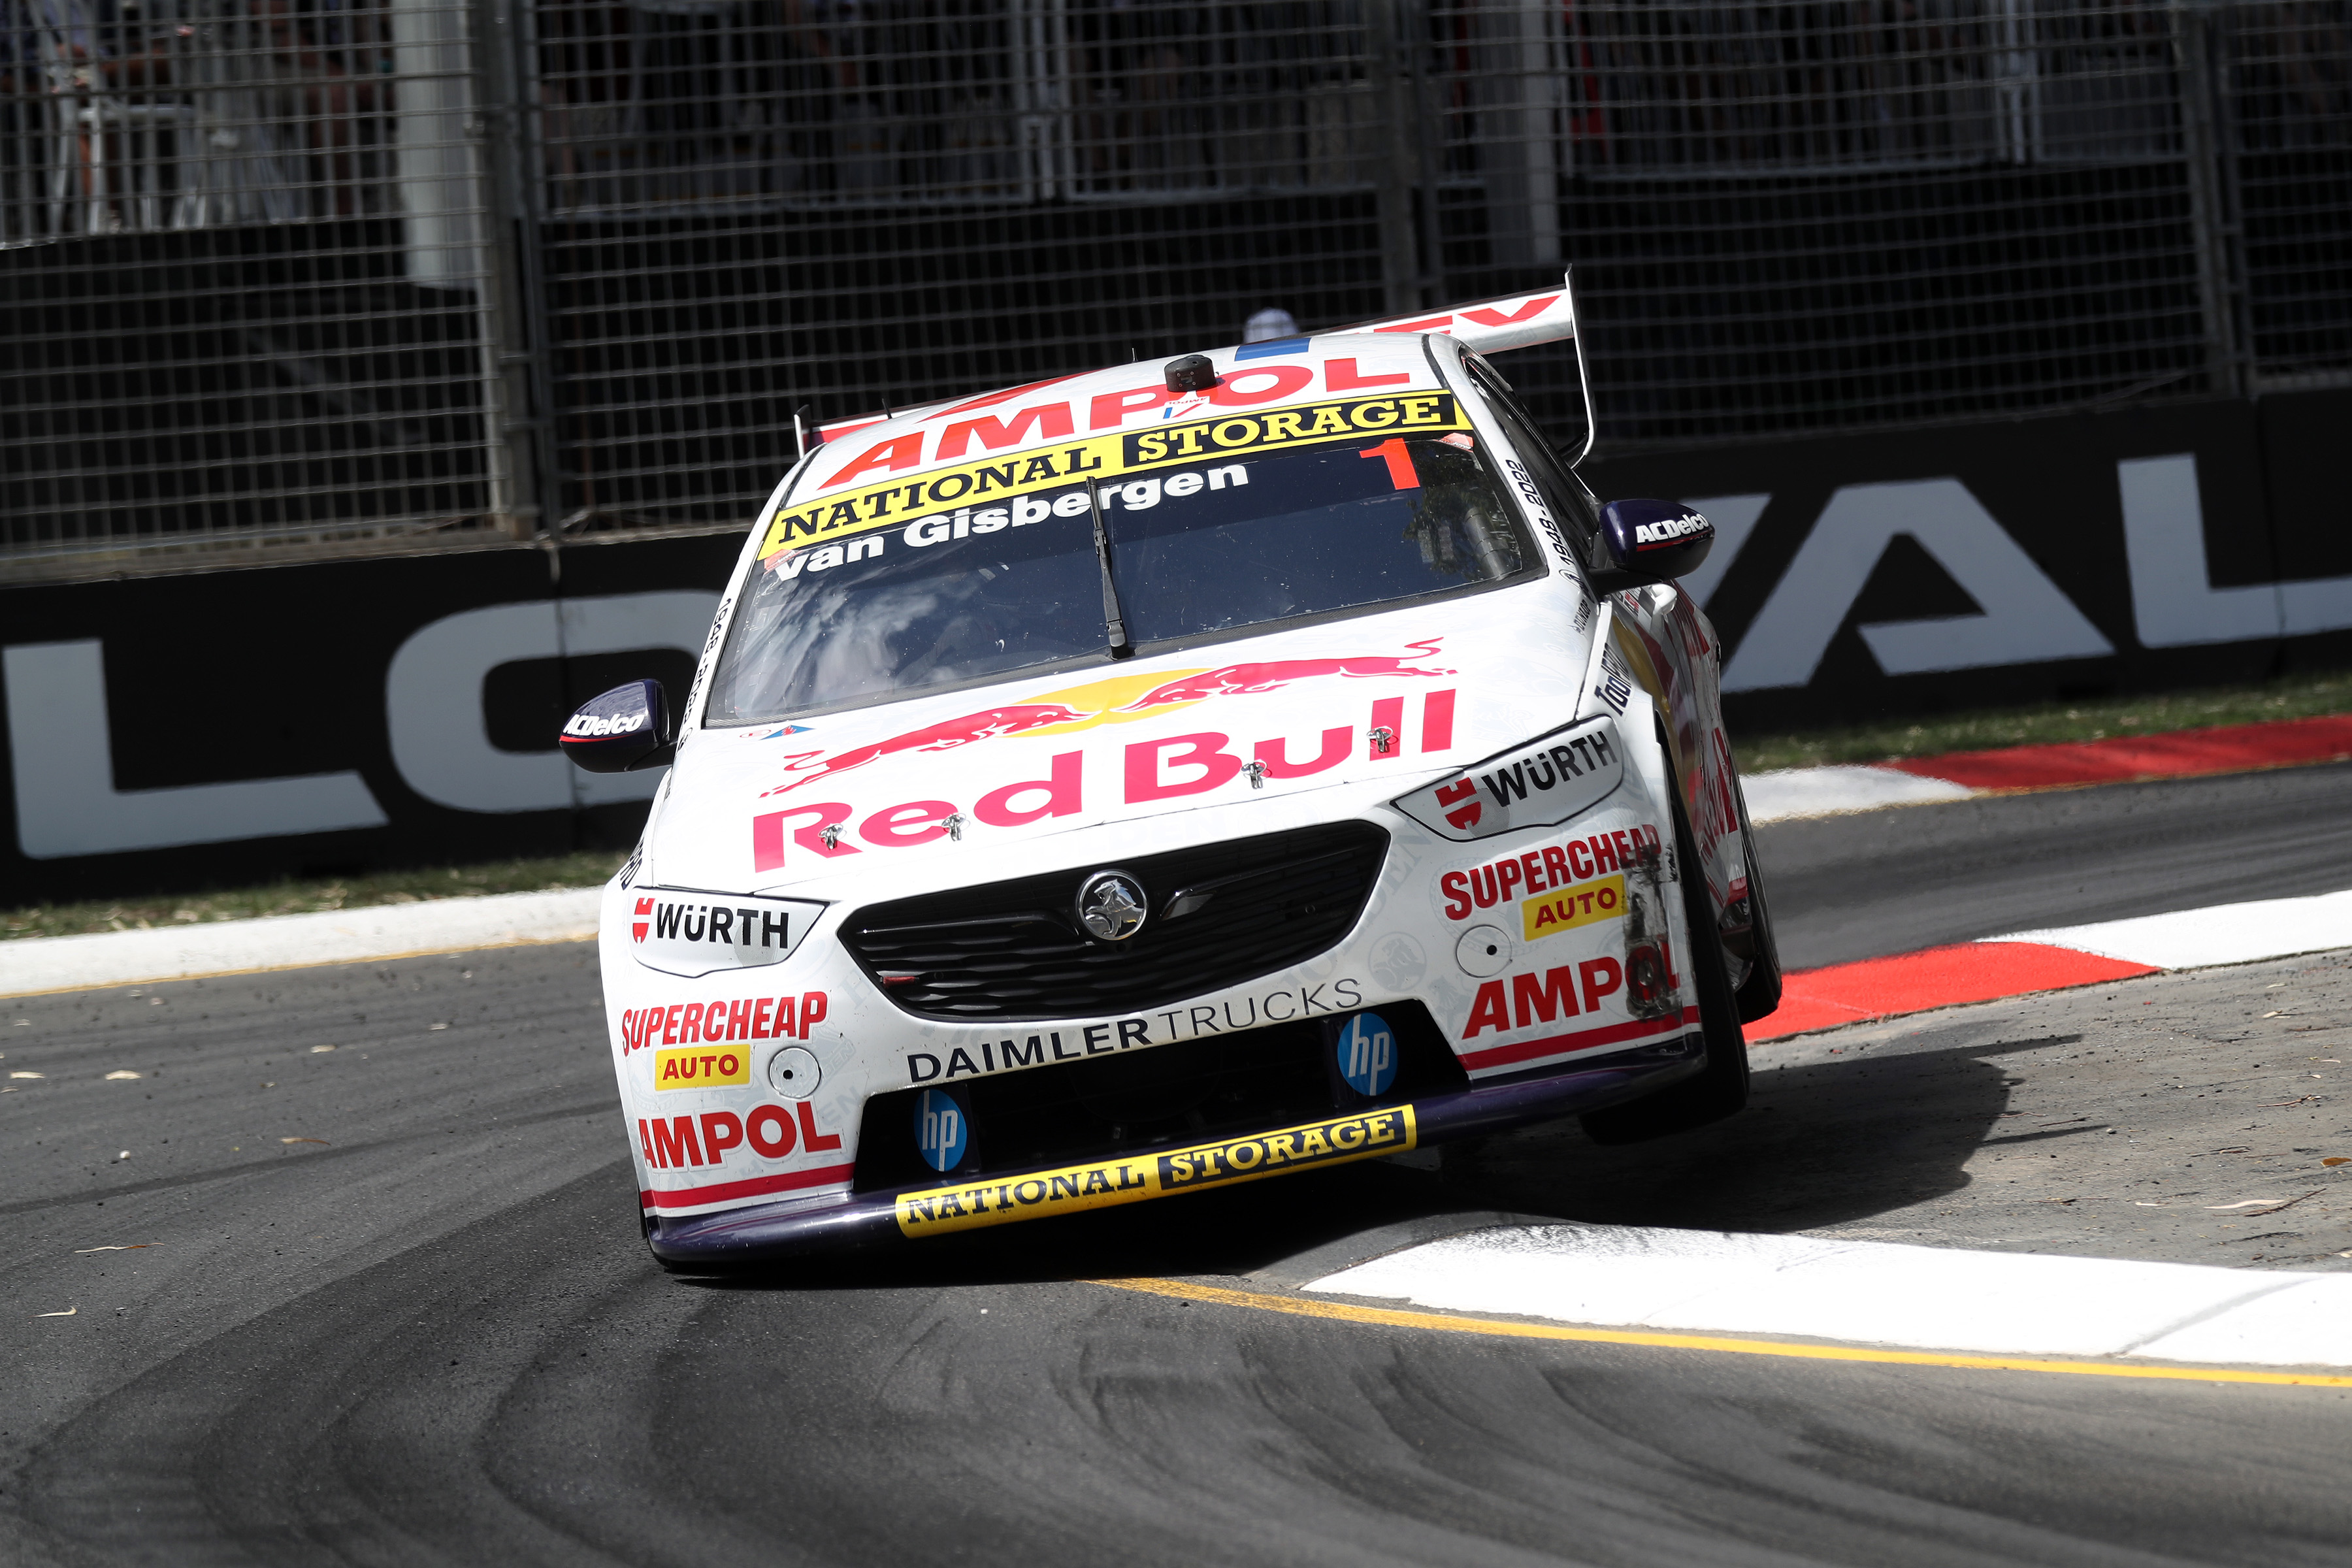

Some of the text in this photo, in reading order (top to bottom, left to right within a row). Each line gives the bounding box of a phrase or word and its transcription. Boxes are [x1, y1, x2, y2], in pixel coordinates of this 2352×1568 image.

[818, 357, 1410, 490] AMPOL
[779, 396, 1441, 544] NATIONAL STORAGE
[1359, 437, 1421, 490] 1
[1505, 459, 1546, 508] 2022
[774, 463, 1249, 582] van Gisbergen
[1539, 517, 1576, 566] 1948
[1635, 513, 1709, 544] ACDelco
[705, 597, 732, 655] 1948
[563, 713, 645, 736] ACDelco
[753, 749, 1083, 873] Red
[1124, 689, 1456, 804] Bull
[1481, 730, 1618, 808] WÜRTH
[1440, 824, 1663, 921] SUPERCHEAP
[656, 902, 789, 949] WÜRTH
[1535, 887, 1617, 929] AUTO
[1462, 934, 1680, 1040] AMPOL
[622, 991, 828, 1056] SUPERCHEAP
[1347, 1012, 1390, 1096] hp
[662, 1054, 740, 1081] AUTO
[638, 1101, 842, 1170] AMPOL
[922, 1088, 959, 1173] hp
[907, 1113, 1396, 1224] NATIONAL STORAGE
